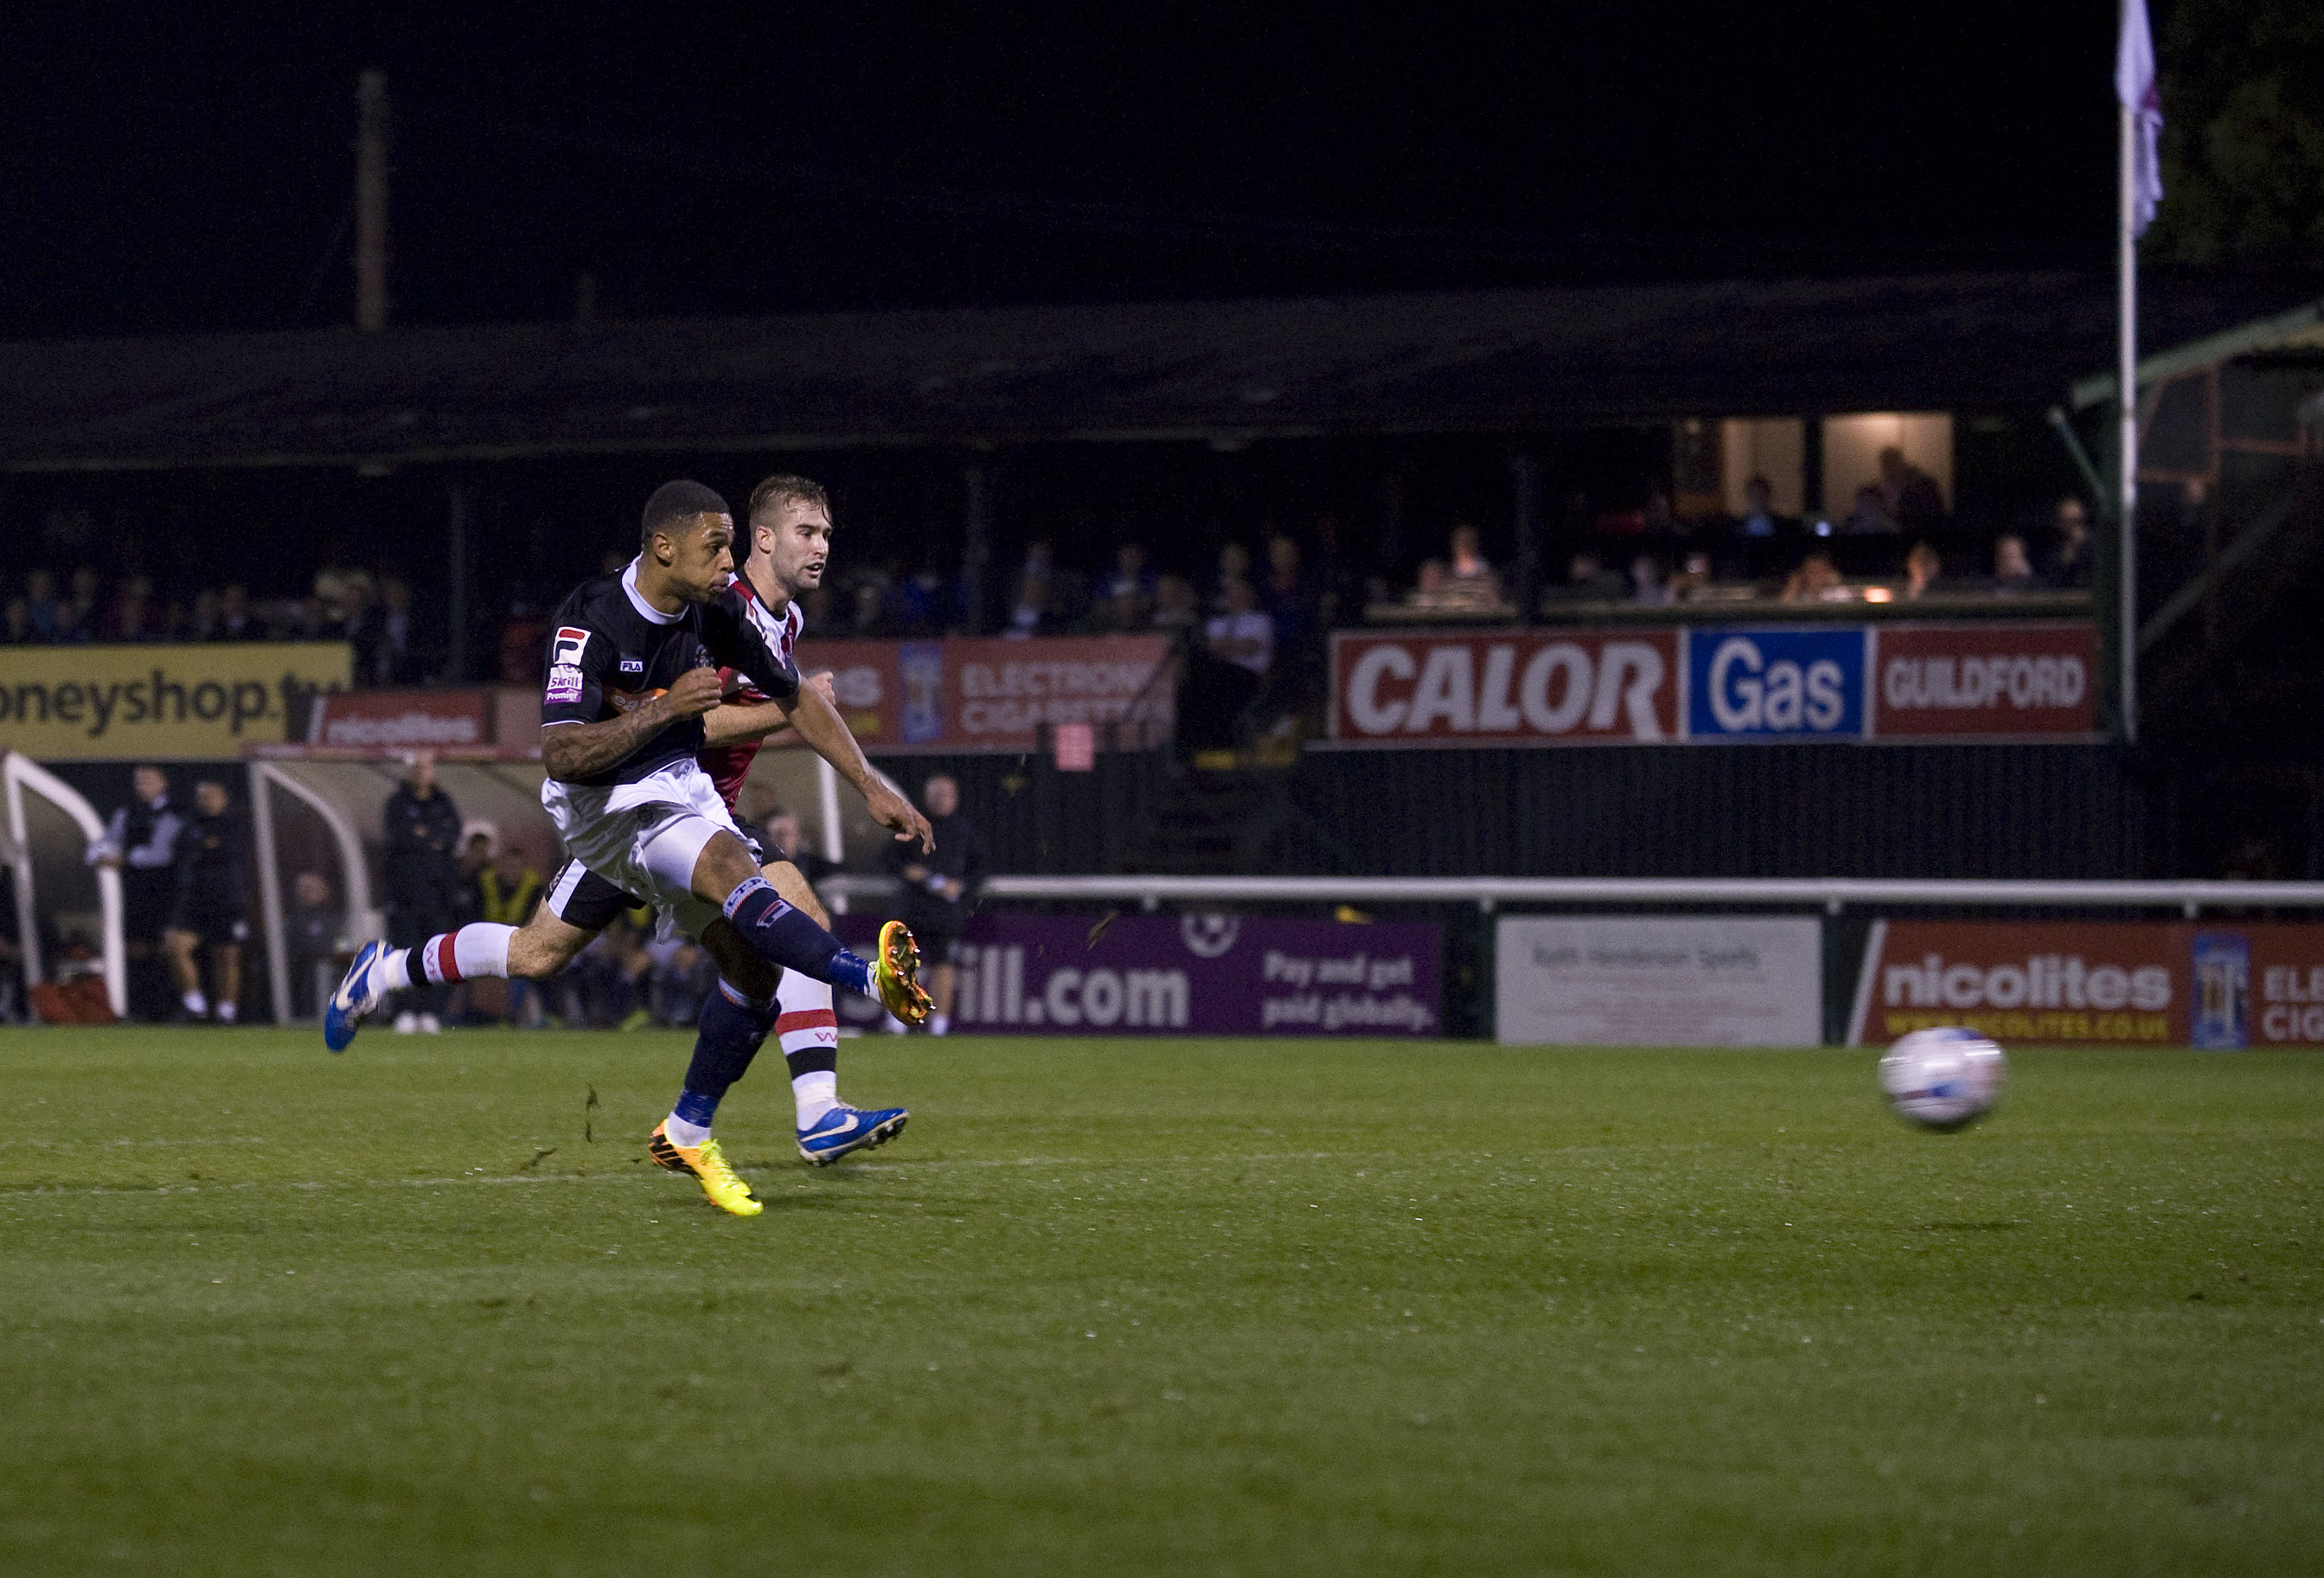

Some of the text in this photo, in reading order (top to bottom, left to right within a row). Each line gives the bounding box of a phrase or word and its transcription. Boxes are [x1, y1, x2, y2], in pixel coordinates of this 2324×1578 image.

[550, 677, 579, 688] Skrill
[622, 663, 641, 671] FILA
[546, 690, 579, 702] Premier
[1347, 637, 2086, 742] CALOR Gas GUILDFORD
[1263, 950, 1414, 991] Pay and get
[1884, 953, 2173, 1010] nicolites
[1262, 994, 1434, 1033] paid globally.
